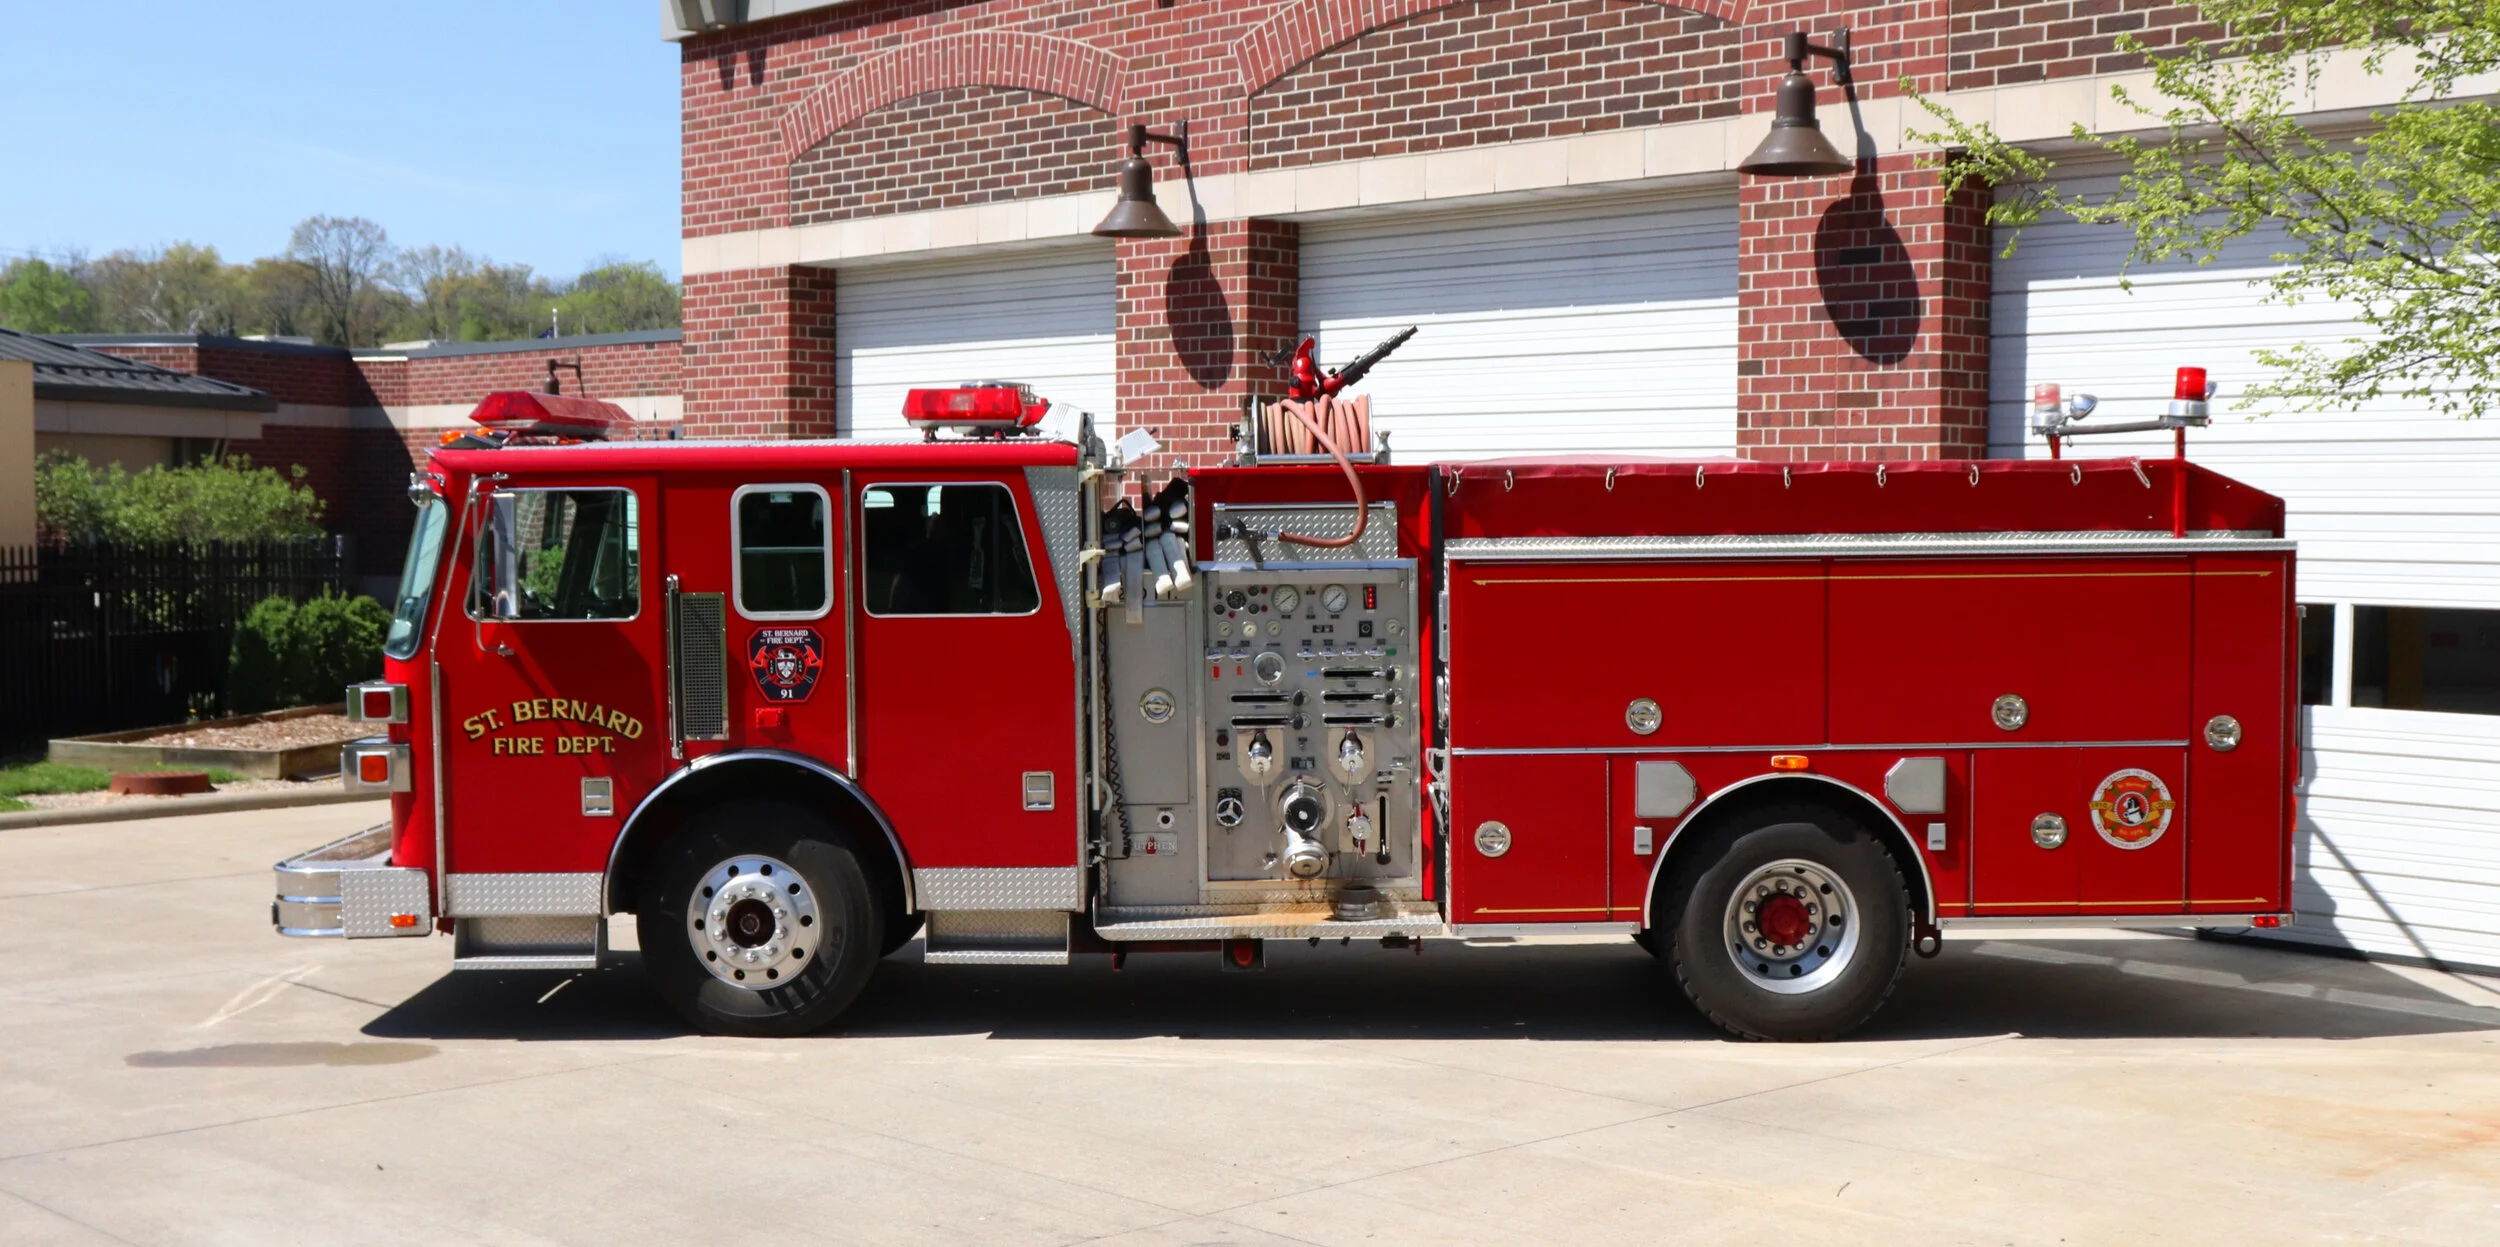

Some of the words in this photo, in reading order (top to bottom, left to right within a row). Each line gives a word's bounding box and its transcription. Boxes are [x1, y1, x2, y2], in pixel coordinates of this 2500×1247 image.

[780, 689, 793, 699] 91
[463, 708, 504, 740] ST.
[512, 698, 643, 740] BERNARD
[494, 737, 545, 754] FIRE
[557, 736, 616, 754] DEPT.
